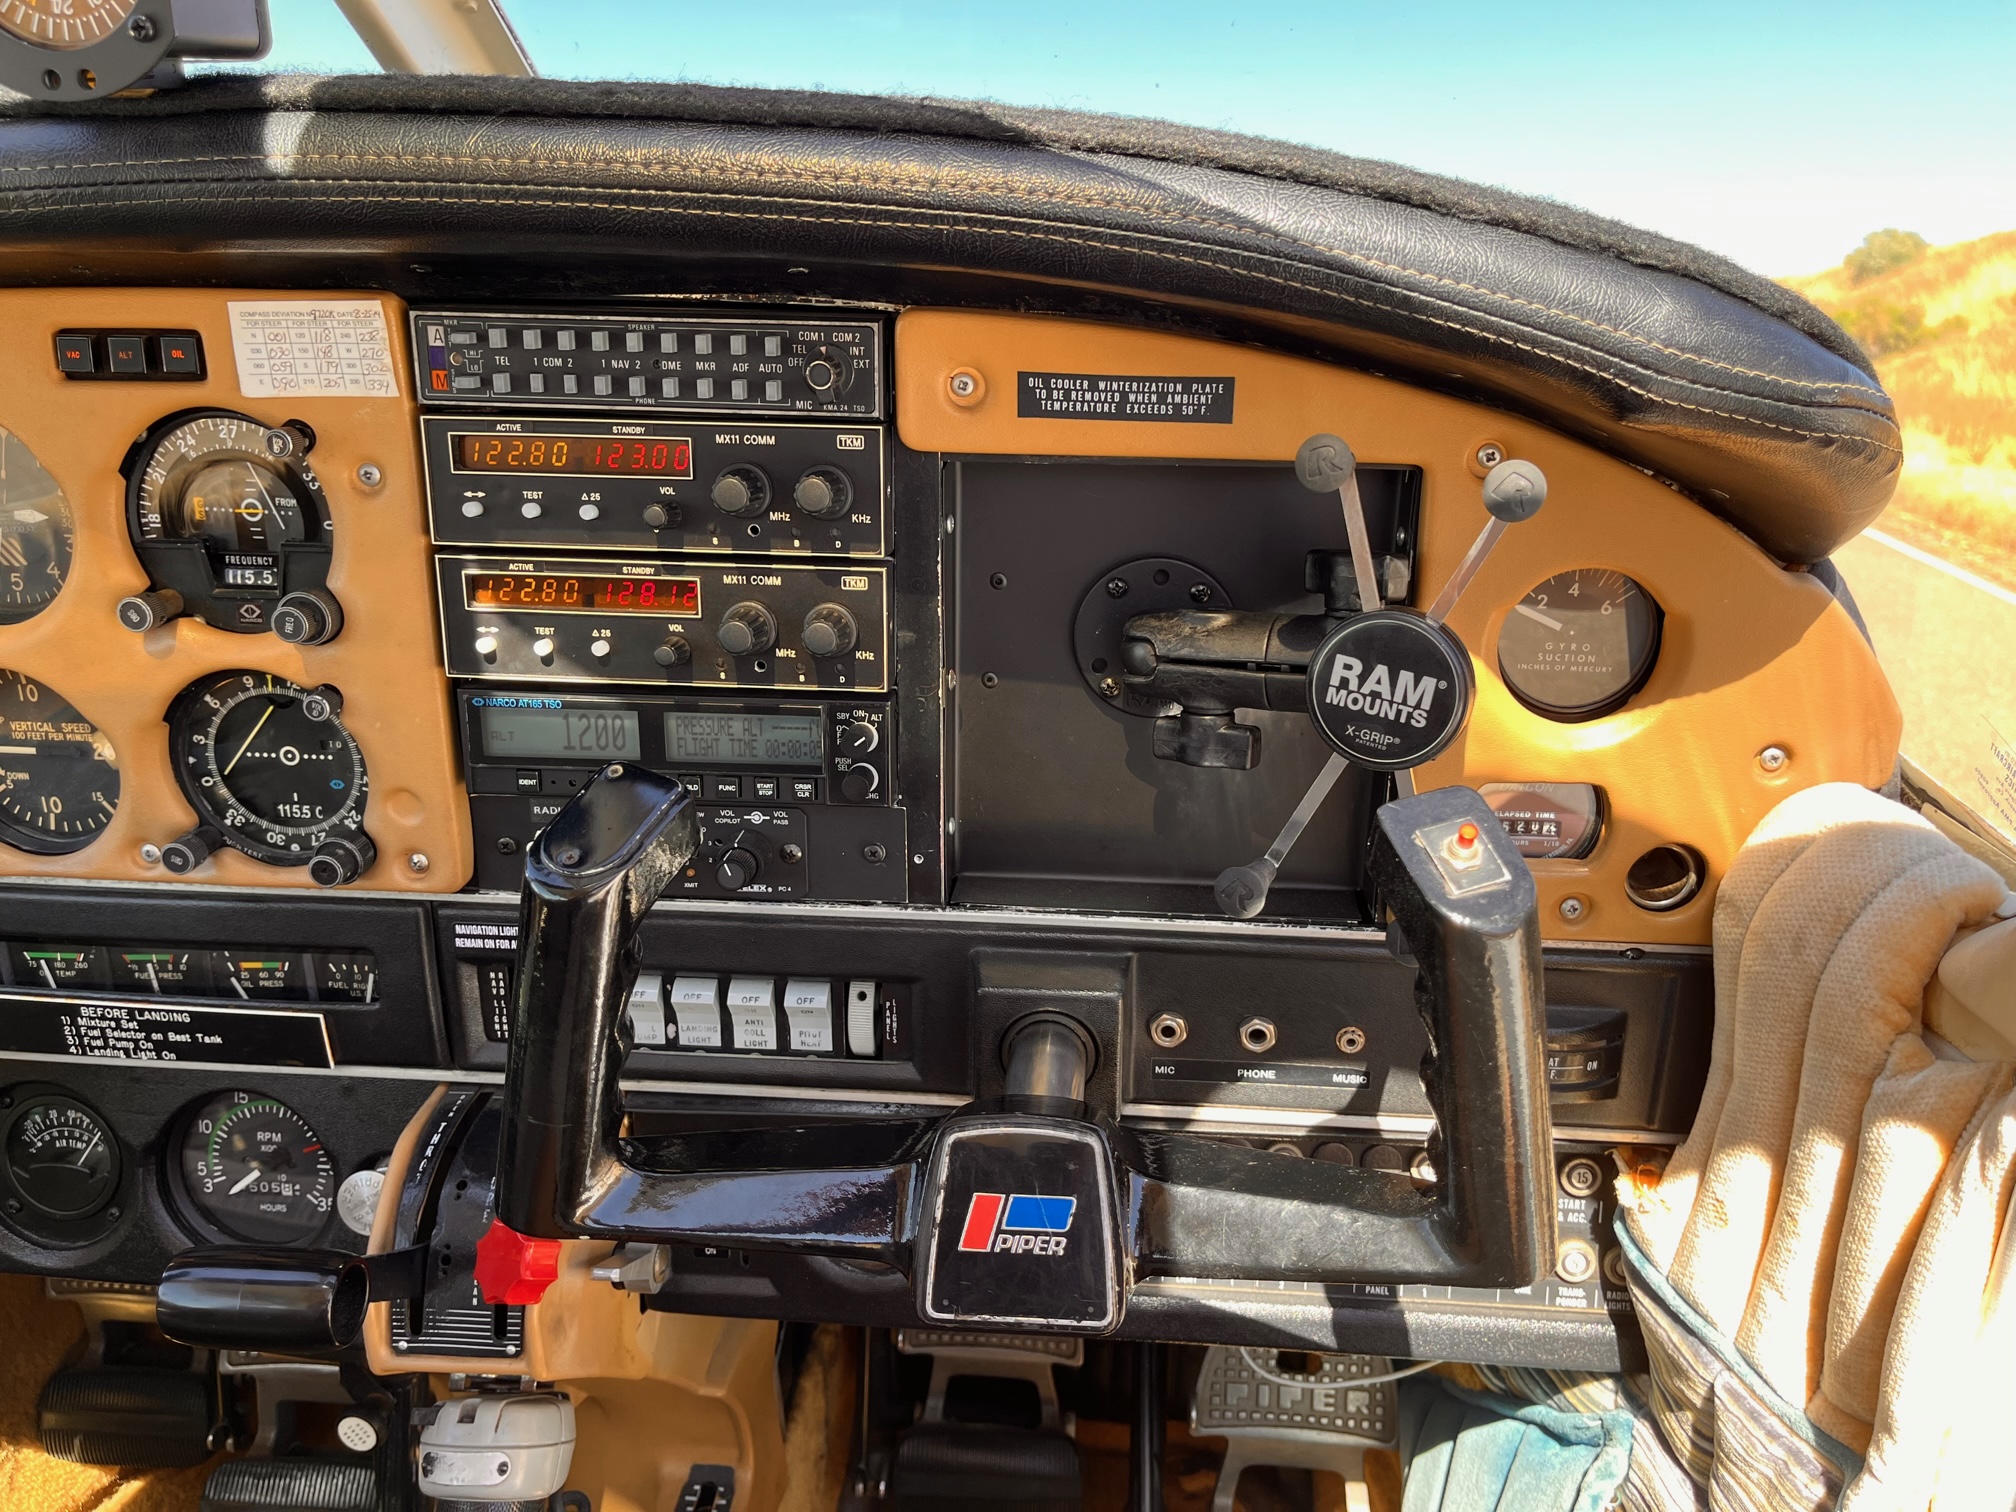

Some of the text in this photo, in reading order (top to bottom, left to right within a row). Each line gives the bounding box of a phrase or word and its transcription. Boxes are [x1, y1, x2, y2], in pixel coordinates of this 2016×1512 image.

[798, 332, 819, 341] COM
[832, 332, 854, 342] COM
[172, 350, 185, 358] OIL
[792, 344, 808, 354] TEL
[850, 346, 865, 356] INT
[66, 350, 80, 359] VAC
[118, 351, 132, 360] ALT
[494, 356, 511, 366] TEL
[543, 358, 563, 367] COM
[612, 360, 630, 369] NAV
[662, 360, 682, 370] DME
[788, 358, 804, 367] OFF
[854, 360, 870, 369] EXT
[696, 362, 716, 371] MKR
[732, 363, 750, 372] ADF
[758, 364, 784, 373] AUTO
[1028, 377, 1224, 394] OIL COOLER WINTERIZATION PLATE
[1035, 388, 1212, 406] TO BE REMOVED WHEN AMBIENT
[796, 400, 813, 410] MIC
[1040, 400, 1174, 416] TEMPERATURE EXCEEDS
[496, 424, 522, 432] ACTIVE
[612, 426, 646, 435] STANDBY
[716, 434, 776, 446] MX11 COMM
[473, 440, 689, 472] 122.80 123.00
[522, 490, 544, 500] TEST
[660, 486, 676, 496] VOL
[275, 498, 298, 508] FROM
[770, 511, 791, 522] MHz
[851, 514, 872, 524] KHz
[225, 556, 273, 566] FREQUENCY
[46, 561, 61, 579] 4
[508, 562, 534, 572] ACTIVE
[622, 566, 656, 575] STANDBY
[10, 572, 24, 592] 5
[723, 575, 782, 586] MX11 COMM
[488, 578, 698, 607] 122.80 128.12
[1568, 582, 1580, 597] 4
[1536, 594, 1548, 610] 2
[1600, 600, 1612, 615] 6
[534, 626, 555, 636] TEST
[668, 624, 684, 632] VOL
[1545, 642, 1591, 652] GYRO
[776, 648, 797, 658] MHz
[856, 650, 875, 660] KHz
[1537, 652, 1596, 664] SUCTION
[1570, 665, 1614, 673] MERCURY
[1329, 653, 1438, 711] RAM
[18, 684, 39, 702] 10
[486, 698, 562, 710] NARCO AT165 TSO
[1325, 686, 1428, 728] MOUNTS
[836, 712, 850, 720] SBY
[870, 714, 884, 722] ALT
[10, 720, 92, 733] VERTICAL SPEED
[676, 716, 764, 738] PRESSURE ALT
[12, 732, 94, 742] 100 FEET PER MINUTE
[562, 712, 626, 752] 1200
[676, 736, 758, 758] FLIGHT TIME
[1355, 738, 1387, 750] PATENTED
[835, 757, 852, 766] PUSH
[7, 772, 30, 781] DOWN
[518, 778, 538, 786] IDENT
[718, 784, 736, 792] FUNC
[41, 796, 62, 814] 10
[1535, 811, 1556, 819] TIME
[455, 924, 499, 936] NAVIGATION
[455, 938, 510, 950] REMAIN ON FOR
[56, 970, 76, 978] TEMP
[158, 972, 184, 980] PRESS
[259, 980, 284, 988] PRESS
[328, 981, 349, 989] FUEL
[741, 996, 761, 1004] OFF
[796, 996, 816, 1006] OFF
[80, 1006, 191, 1023] BEFORE LANDING
[60, 1016, 139, 1030] 1) Mixture Set
[64, 1026, 224, 1044] 2) Fuel Selector Best Tank
[687, 1036, 712, 1044] LIGHT
[66, 1036, 154, 1050] 3) Fuel Pump On
[744, 1040, 768, 1048] LIGHT
[69, 1045, 177, 1060] 4) Landing Light On
[1154, 1065, 1176, 1075] MIC
[1237, 1068, 1276, 1080] PHONE
[1332, 1073, 1368, 1084] MUSIC
[198, 1120, 213, 1134] 10
[256, 1132, 282, 1142] RPM
[55, 1138, 87, 1150] AIR TEMP
[197, 1162, 208, 1176] 5
[203, 1178, 214, 1192] 3
[260, 1204, 288, 1212] HOURS
[1558, 1198, 1586, 1210] START
[994, 1234, 1068, 1256] PIPER
[1365, 1285, 1390, 1296] PANEL
[1606, 1290, 1630, 1300] RADIO
[1604, 1300, 1631, 1311] LIGHTS
[1226, 1382, 1370, 1416] PIPER
